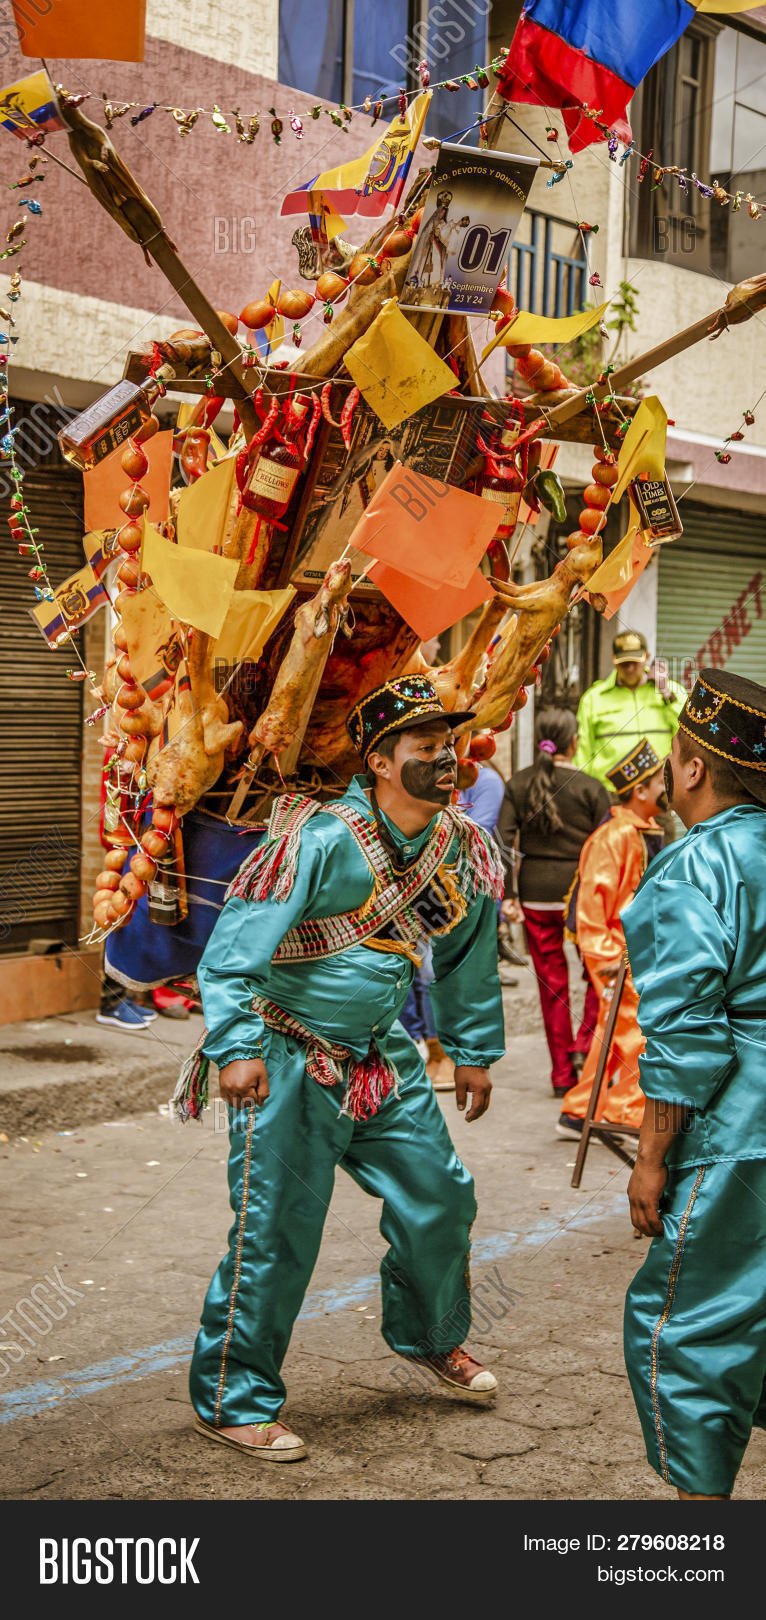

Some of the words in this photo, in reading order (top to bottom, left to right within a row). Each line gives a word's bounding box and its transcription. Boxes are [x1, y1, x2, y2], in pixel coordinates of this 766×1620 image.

[452, 166, 488, 177] DEVOTOS
[489, 168, 494, 176] Y
[495, 171, 527, 202] DONANTES
[458, 224, 512, 275] 01
[451, 281, 494, 294] Septiembre
[454, 294, 465, 304] 23
[466, 295, 472, 303] Y
[473, 295, 483, 305] 24
[259, 473, 290, 489] BELLOWS
[643, 482, 660, 493] OLD
[642, 488, 665, 501] TIMES
